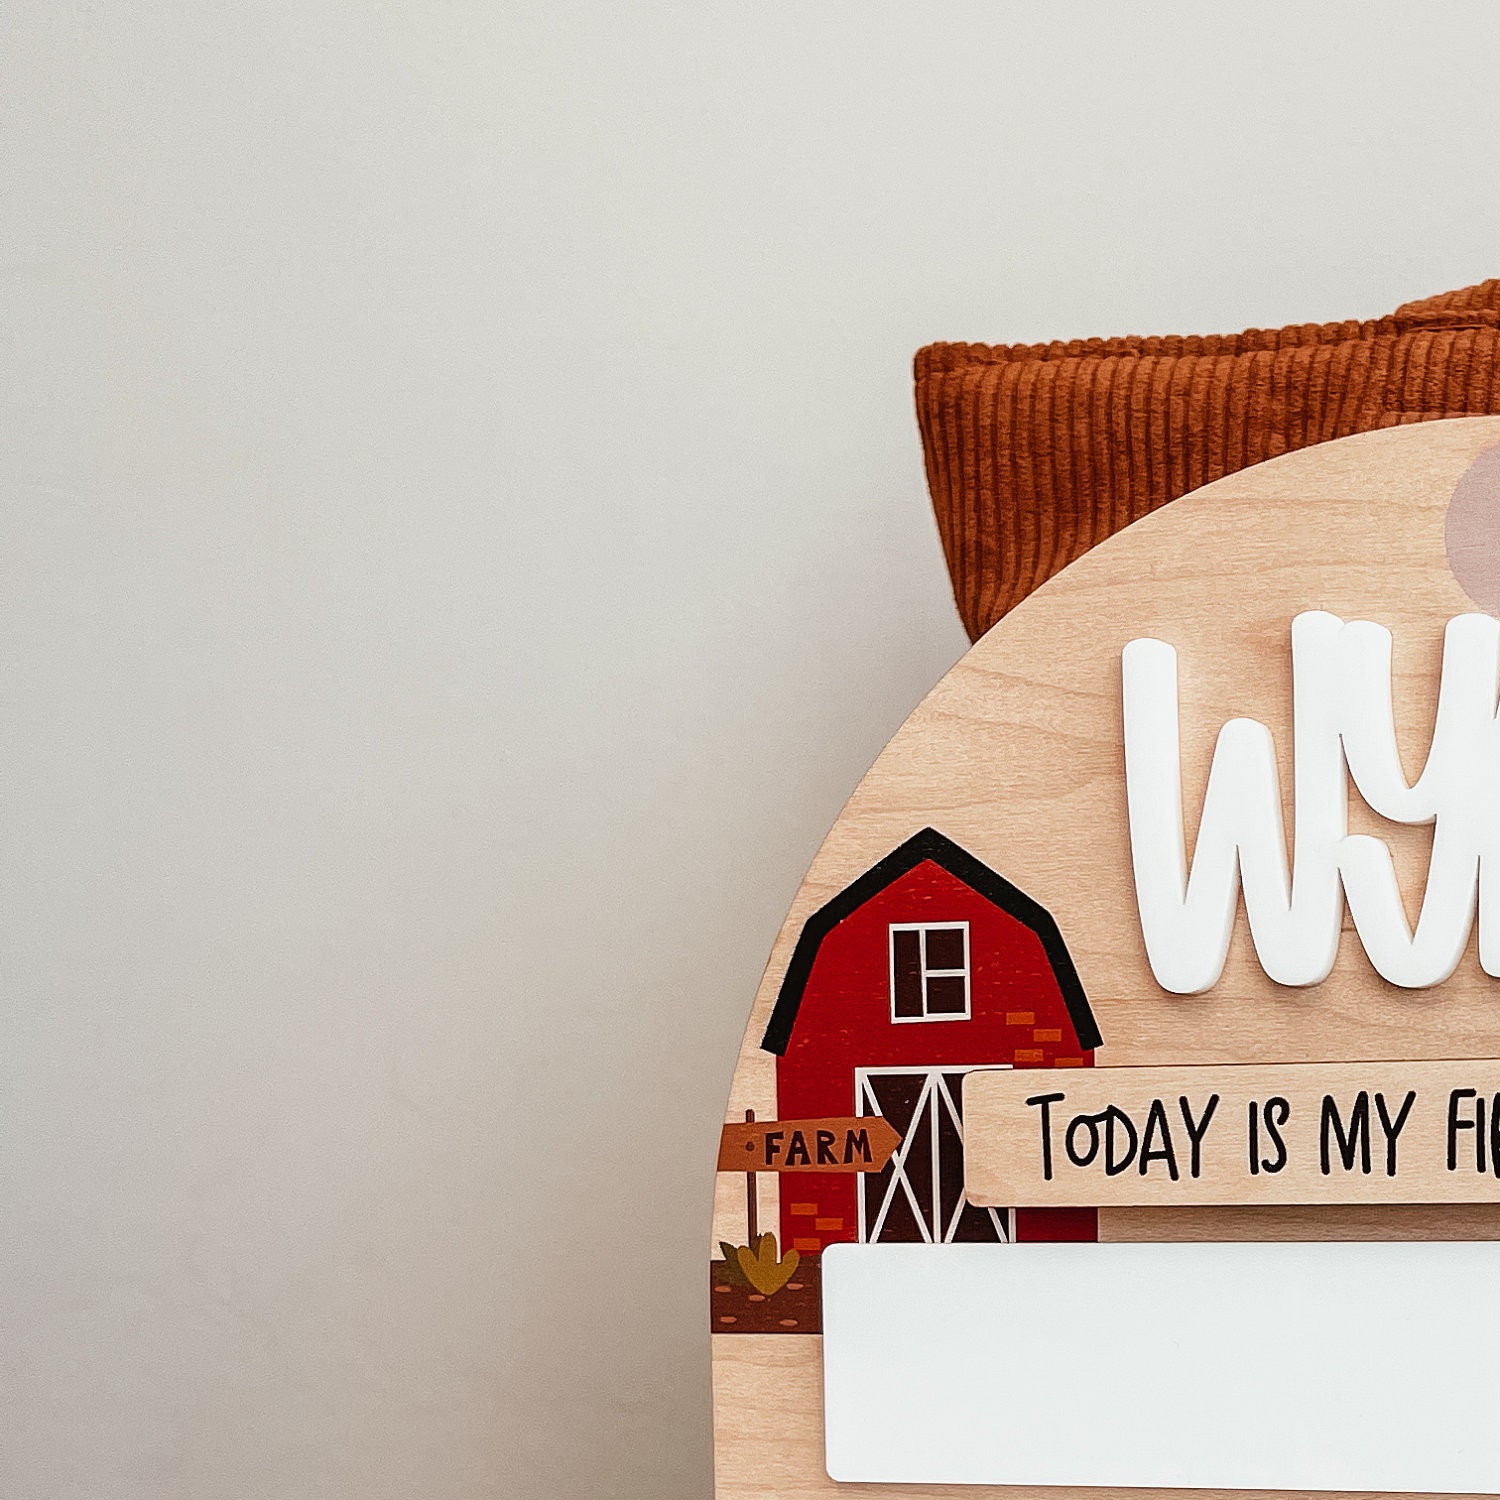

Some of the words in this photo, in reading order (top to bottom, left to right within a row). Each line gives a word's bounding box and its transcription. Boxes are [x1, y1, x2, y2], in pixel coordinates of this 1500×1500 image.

[764, 1130, 873, 1166] FARM
[1248, 1096, 1290, 1176] IS
[1319, 1090, 1417, 1177] MY
